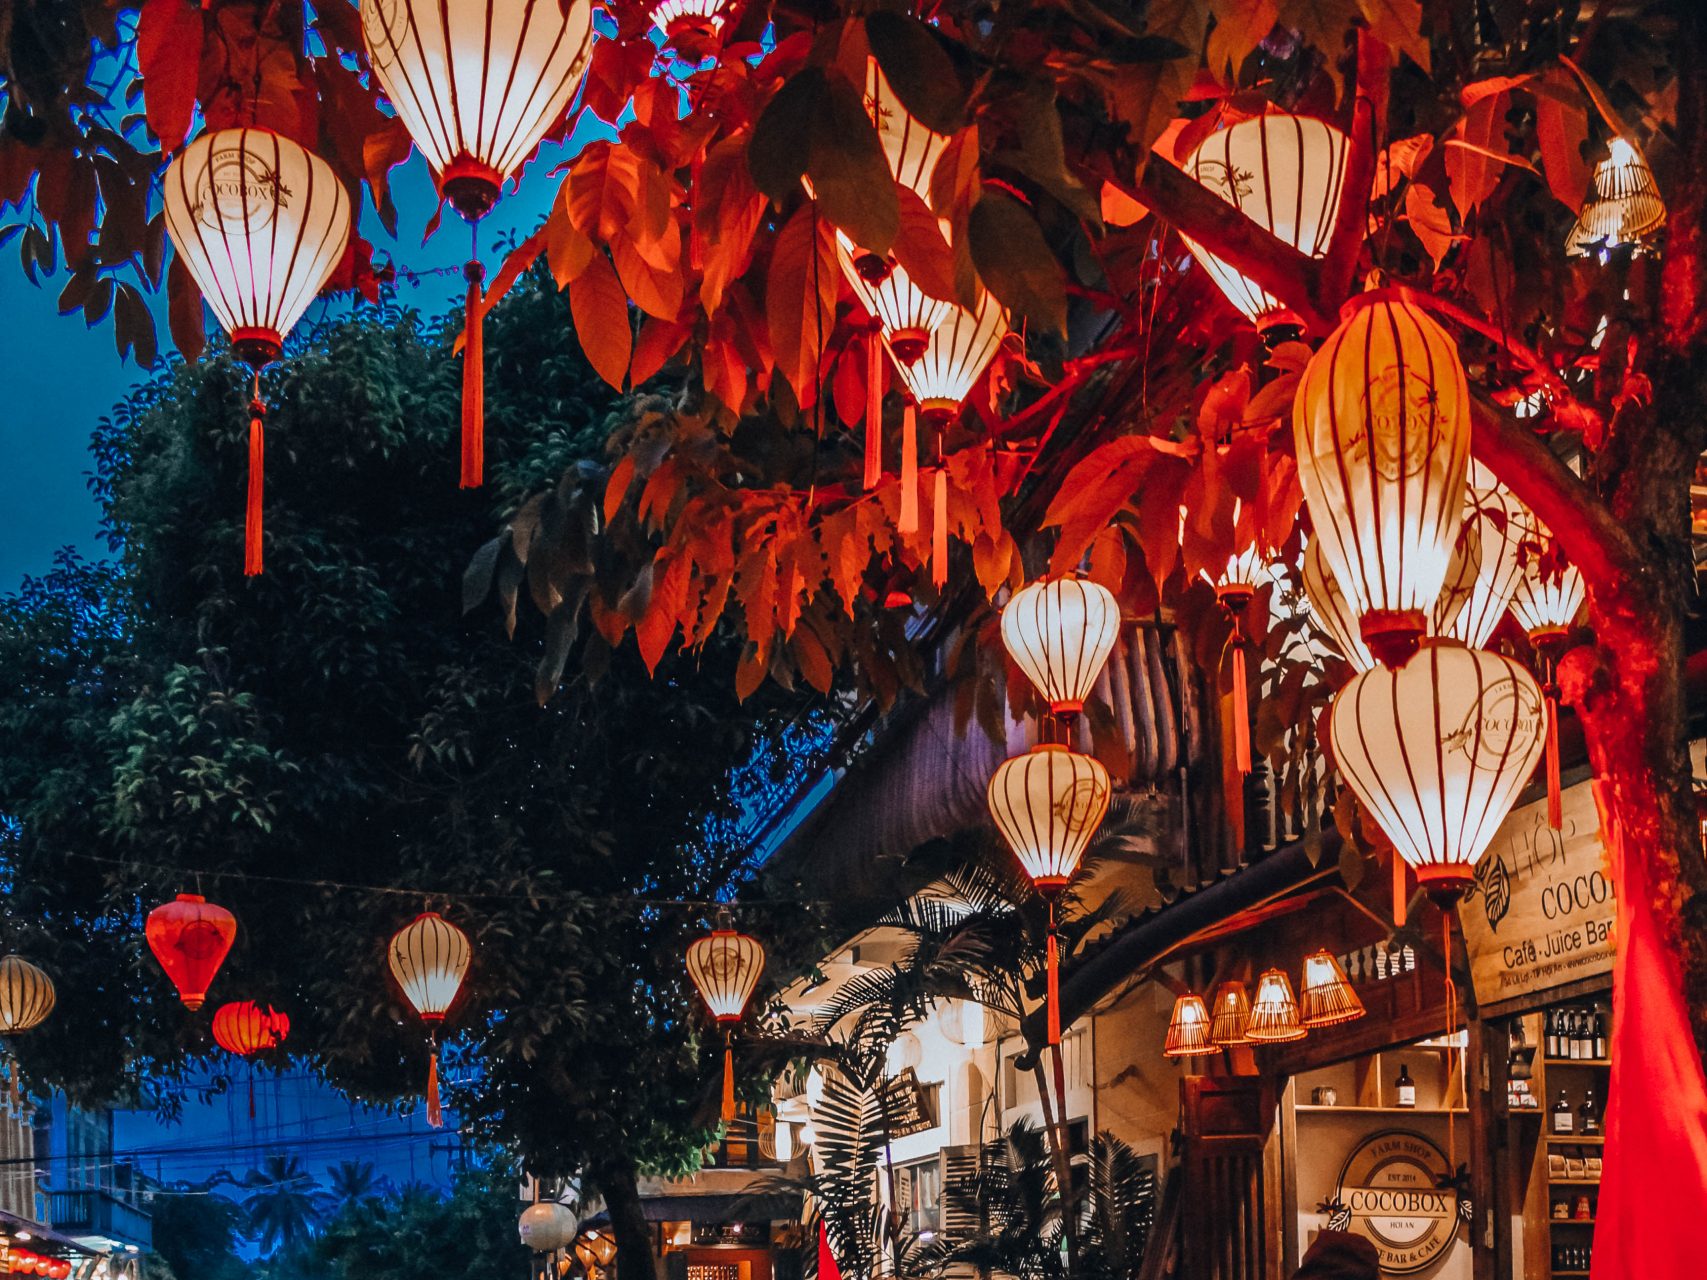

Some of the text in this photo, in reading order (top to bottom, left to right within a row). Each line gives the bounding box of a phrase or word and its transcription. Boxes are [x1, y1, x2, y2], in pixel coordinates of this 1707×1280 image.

[202, 183, 268, 201] COCOOX
[1503, 920, 1613, 969] Café Juice Bar
[1371, 1141, 1432, 1159] FARM SHOP
[1387, 1173, 1416, 1182] EST 2014
[1350, 1191, 1448, 1213] COCOBOX
[1390, 1221, 1415, 1229] HOI AN
[1386, 1251, 1407, 1264] BAR
[1409, 1252, 1418, 1262] &
[1418, 1234, 1441, 1258] CAFE
